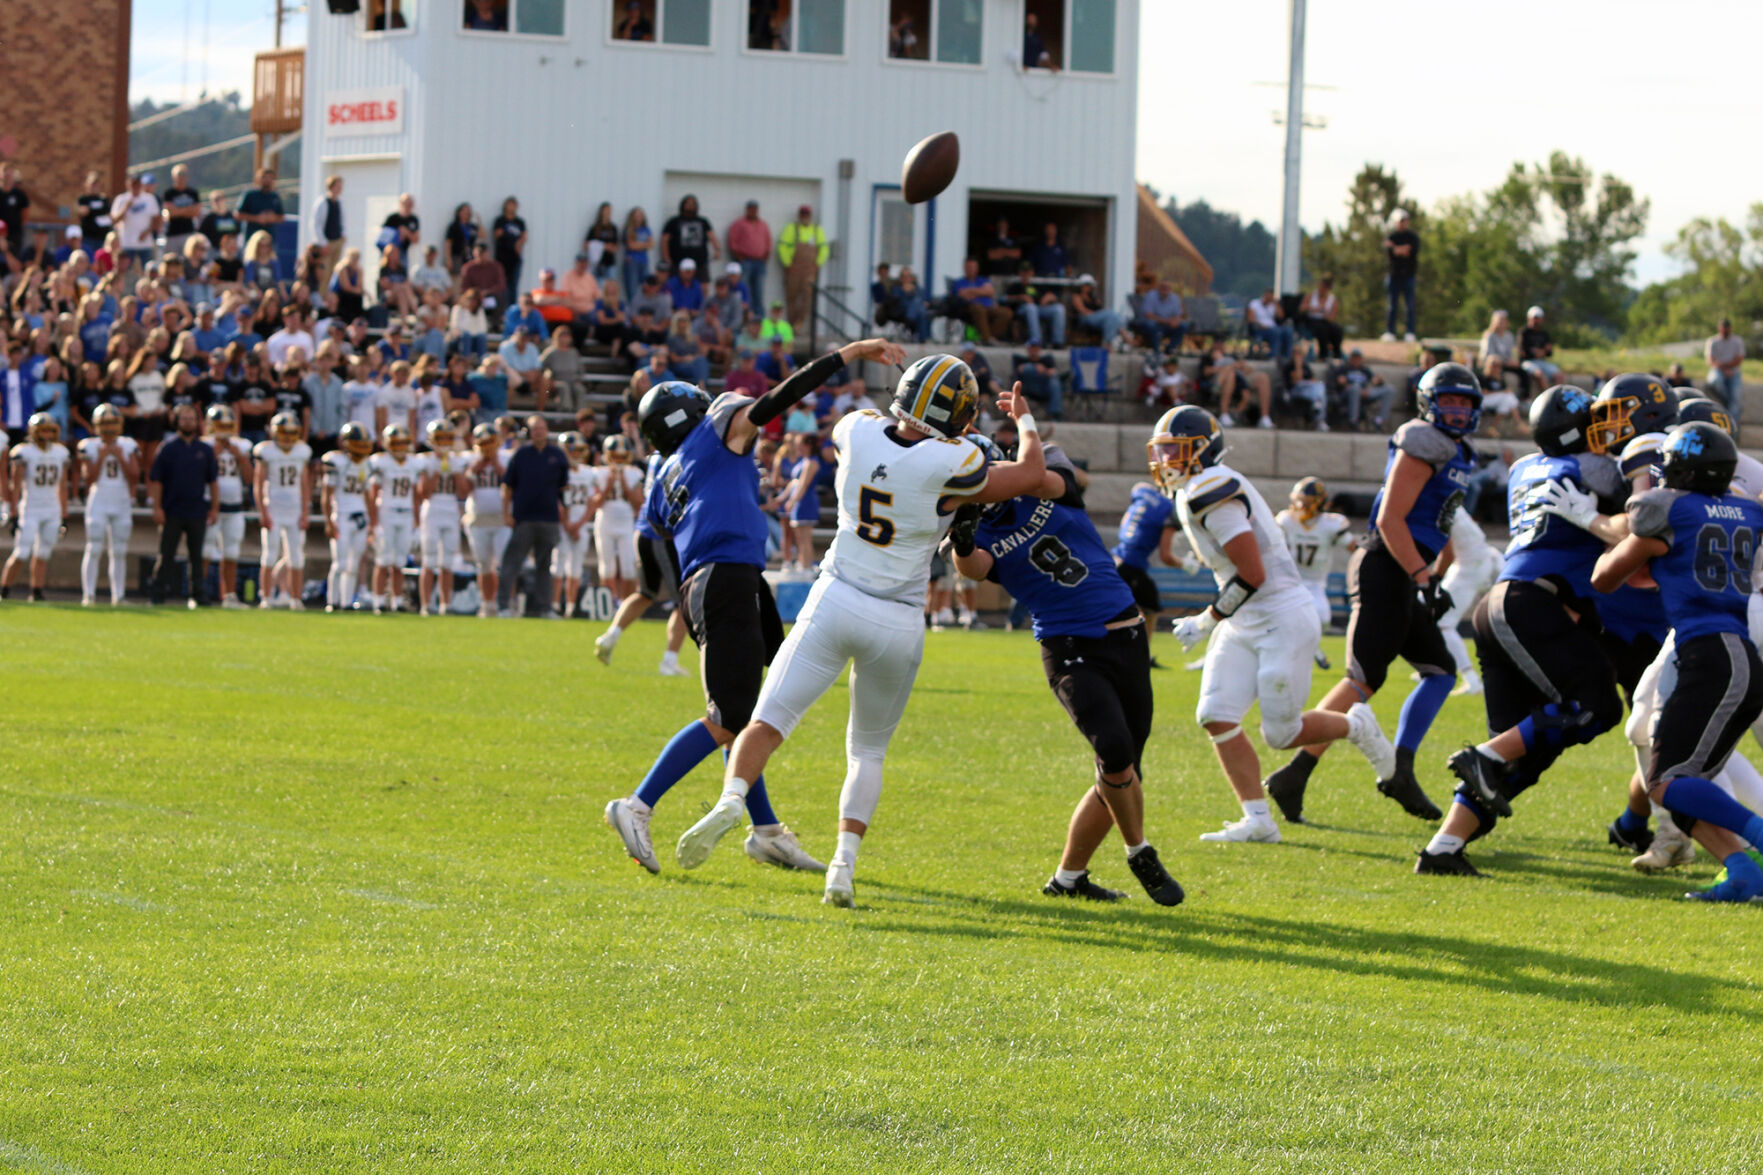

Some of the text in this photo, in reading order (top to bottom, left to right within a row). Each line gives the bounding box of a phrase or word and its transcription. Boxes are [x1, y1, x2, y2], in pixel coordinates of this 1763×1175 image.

[327, 99, 397, 126] SCHEELS
[1647, 382, 1667, 404] 3
[279, 465, 298, 487] 12
[856, 483, 896, 549] 5
[990, 497, 1055, 559] CAVALIERS
[1704, 504, 1746, 521] MORE
[1028, 533, 1089, 588] 8
[1295, 543, 1320, 567] 17
[1693, 522, 1754, 596] 69
[580, 585, 613, 621] 40
